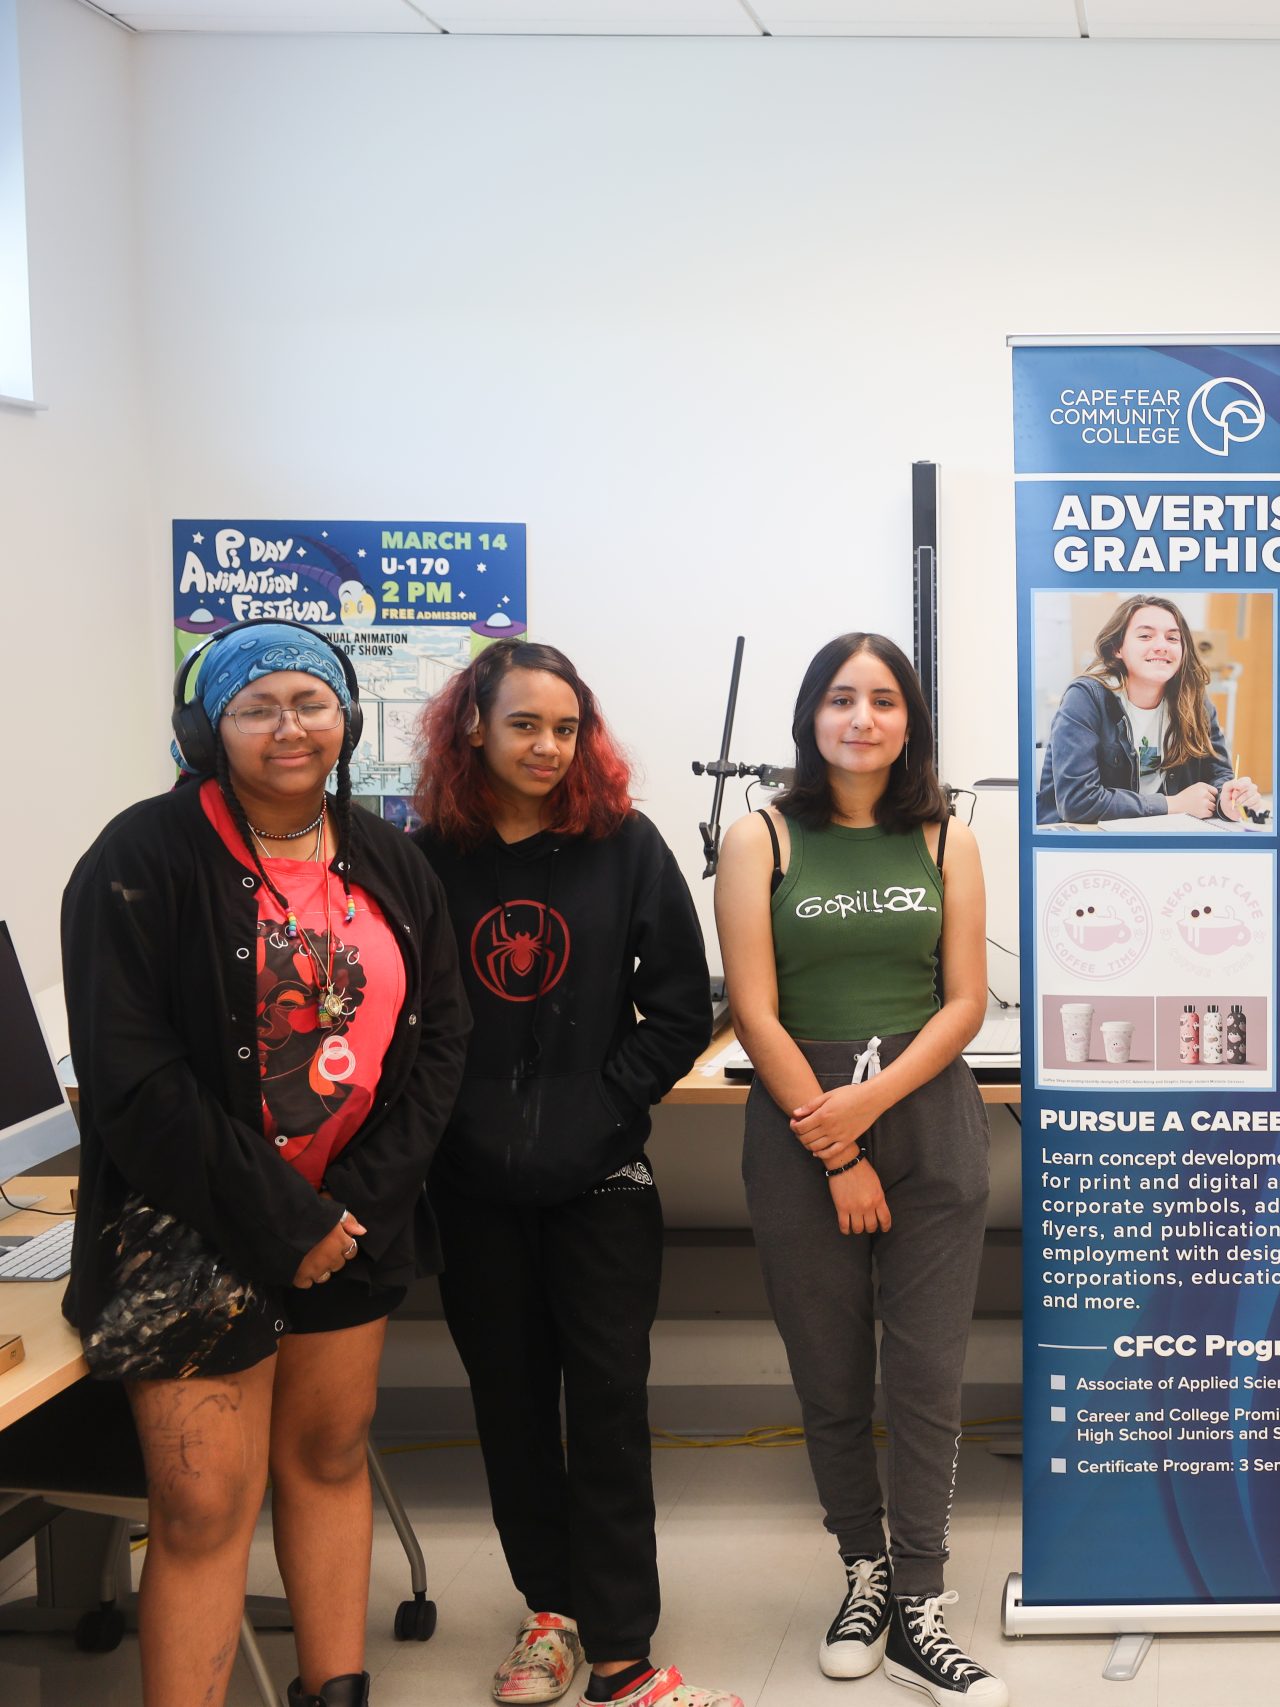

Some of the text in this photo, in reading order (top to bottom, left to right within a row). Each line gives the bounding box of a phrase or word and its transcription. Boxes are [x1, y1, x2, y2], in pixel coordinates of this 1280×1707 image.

[1060, 389, 1181, 406] CAPE FEAR
[1049, 408, 1181, 425] COMMUNITY
[1081, 427, 1180, 444] COLLEGE
[249, 537, 294, 562] DAY
[381, 530, 508, 551] MARCH 14
[381, 556, 450, 576] U-170
[381, 580, 452, 603] 2 PM
[381, 608, 477, 621] FREE ADMISSION
[354, 632, 408, 644] ANIMATION
[344, 645, 356, 656] OF
[359, 645, 393, 656] SHOWS
[1050, 877, 1145, 925] NEKO ESPRESSO
[1160, 875, 1264, 921] NEKO CAT CAFE
[1055, 941, 1096, 974] COFFEE
[1107, 947, 1138, 973] TIME
[1040, 1108, 1155, 1132] PURSUE
[1161, 1111, 1185, 1132] A
[1042, 1147, 1093, 1166] Learn
[1099, 1150, 1177, 1170] concept
[1041, 1171, 1071, 1189] for
[1079, 1173, 1131, 1193] print
[1139, 1173, 1179, 1190] and
[1188, 1172, 1258, 1194] digital
[1042, 1199, 1145, 1217] corporate
[1152, 1197, 1246, 1218] symbols,
[1041, 1219, 1105, 1241] flyers,
[1113, 1221, 1152, 1238] and
[1042, 1245, 1169, 1266] employment
[1175, 1244, 1219, 1261] with
[1042, 1269, 1183, 1289] corporations,
[1043, 1293, 1140, 1310] and more.
[1113, 1334, 1197, 1358] CFCC
[1076, 1377, 1154, 1391] Associate
[1157, 1376, 1175, 1390] of
[1177, 1375, 1239, 1393] Applied
[1076, 1409, 1131, 1423] Career
[1134, 1408, 1164, 1422] and
[1169, 1408, 1230, 1424] College
[1077, 1428, 1114, 1445] High
[1118, 1427, 1172, 1441] School
[1176, 1427, 1235, 1441] Juniors
[1238, 1426, 1268, 1440] and
[1077, 1459, 1159, 1474] Certificate
[1163, 1459, 1234, 1475] Program:
[1239, 1458, 1249, 1472] 3
